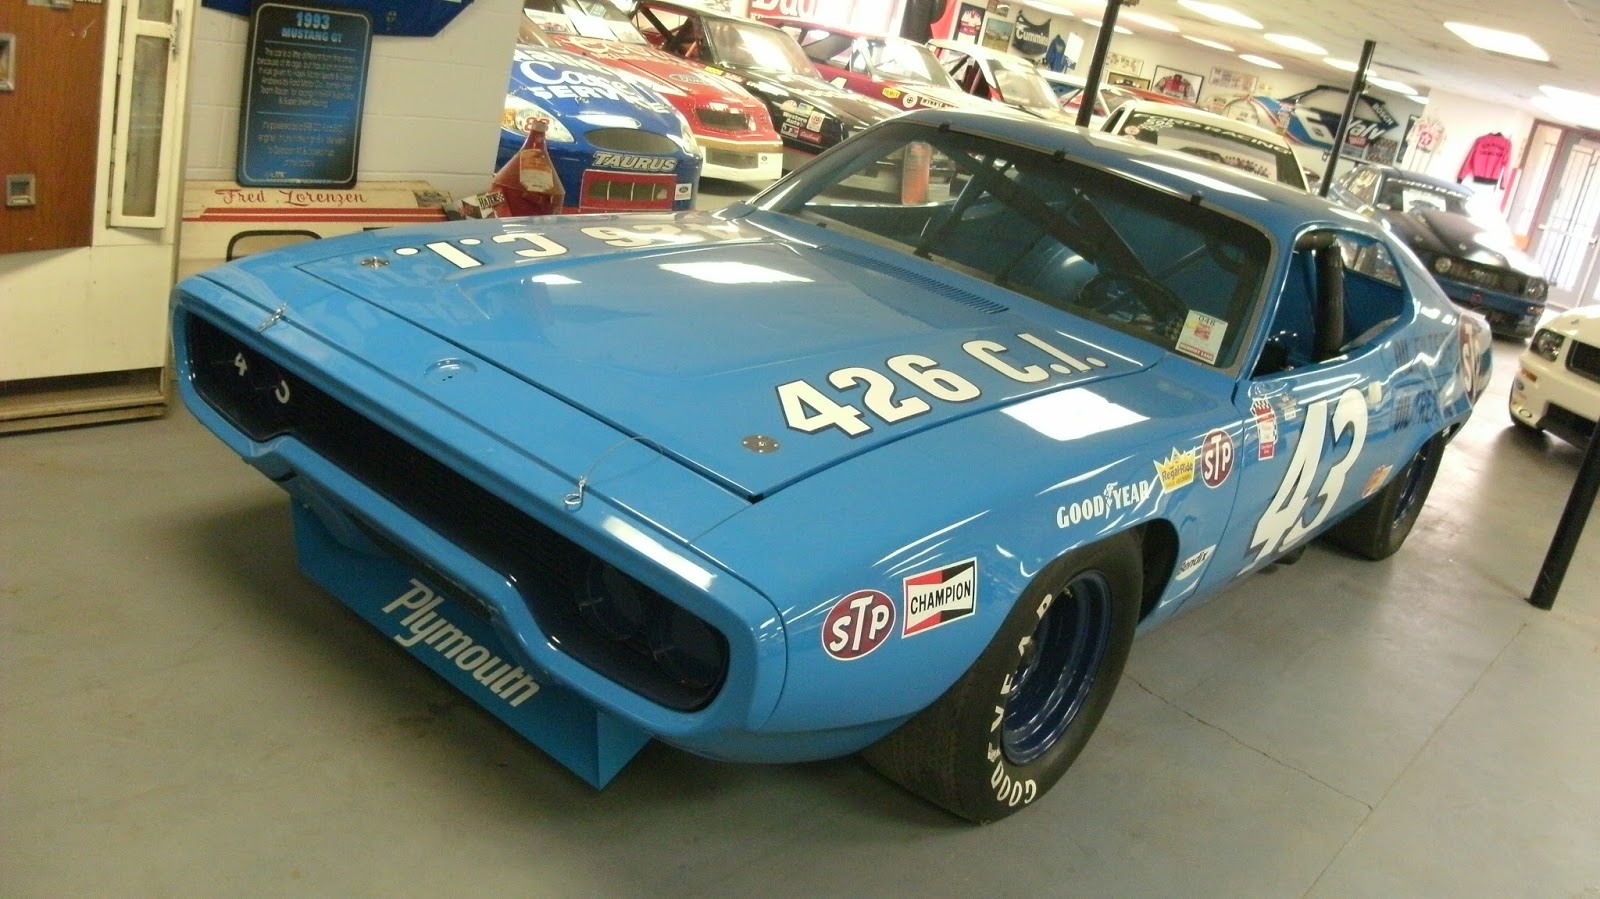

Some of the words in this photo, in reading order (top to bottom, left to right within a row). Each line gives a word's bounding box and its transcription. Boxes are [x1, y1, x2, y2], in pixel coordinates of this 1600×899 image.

[281, 27, 329, 41] MUSTANG
[330, 32, 343, 42] GT
[296, 11, 331, 30] 1993
[782, 111, 807, 123] Western
[1372, 103, 1393, 125] BOSCH
[1204, 125, 1291, 154] RACING
[593, 151, 678, 172] TAURUS
[214, 188, 267, 205] Fred
[279, 189, 367, 206] Lorenzen
[775, 353, 981, 438] 426
[961, 332, 1109, 384] C.I.
[1204, 434, 1231, 481] STP
[1240, 388, 1368, 575] 43
[1056, 479, 1150, 529] GOODYEAR
[910, 580, 971, 615] CHAMPION
[829, 595, 888, 652] STP
[382, 578, 540, 708] Plymouth
